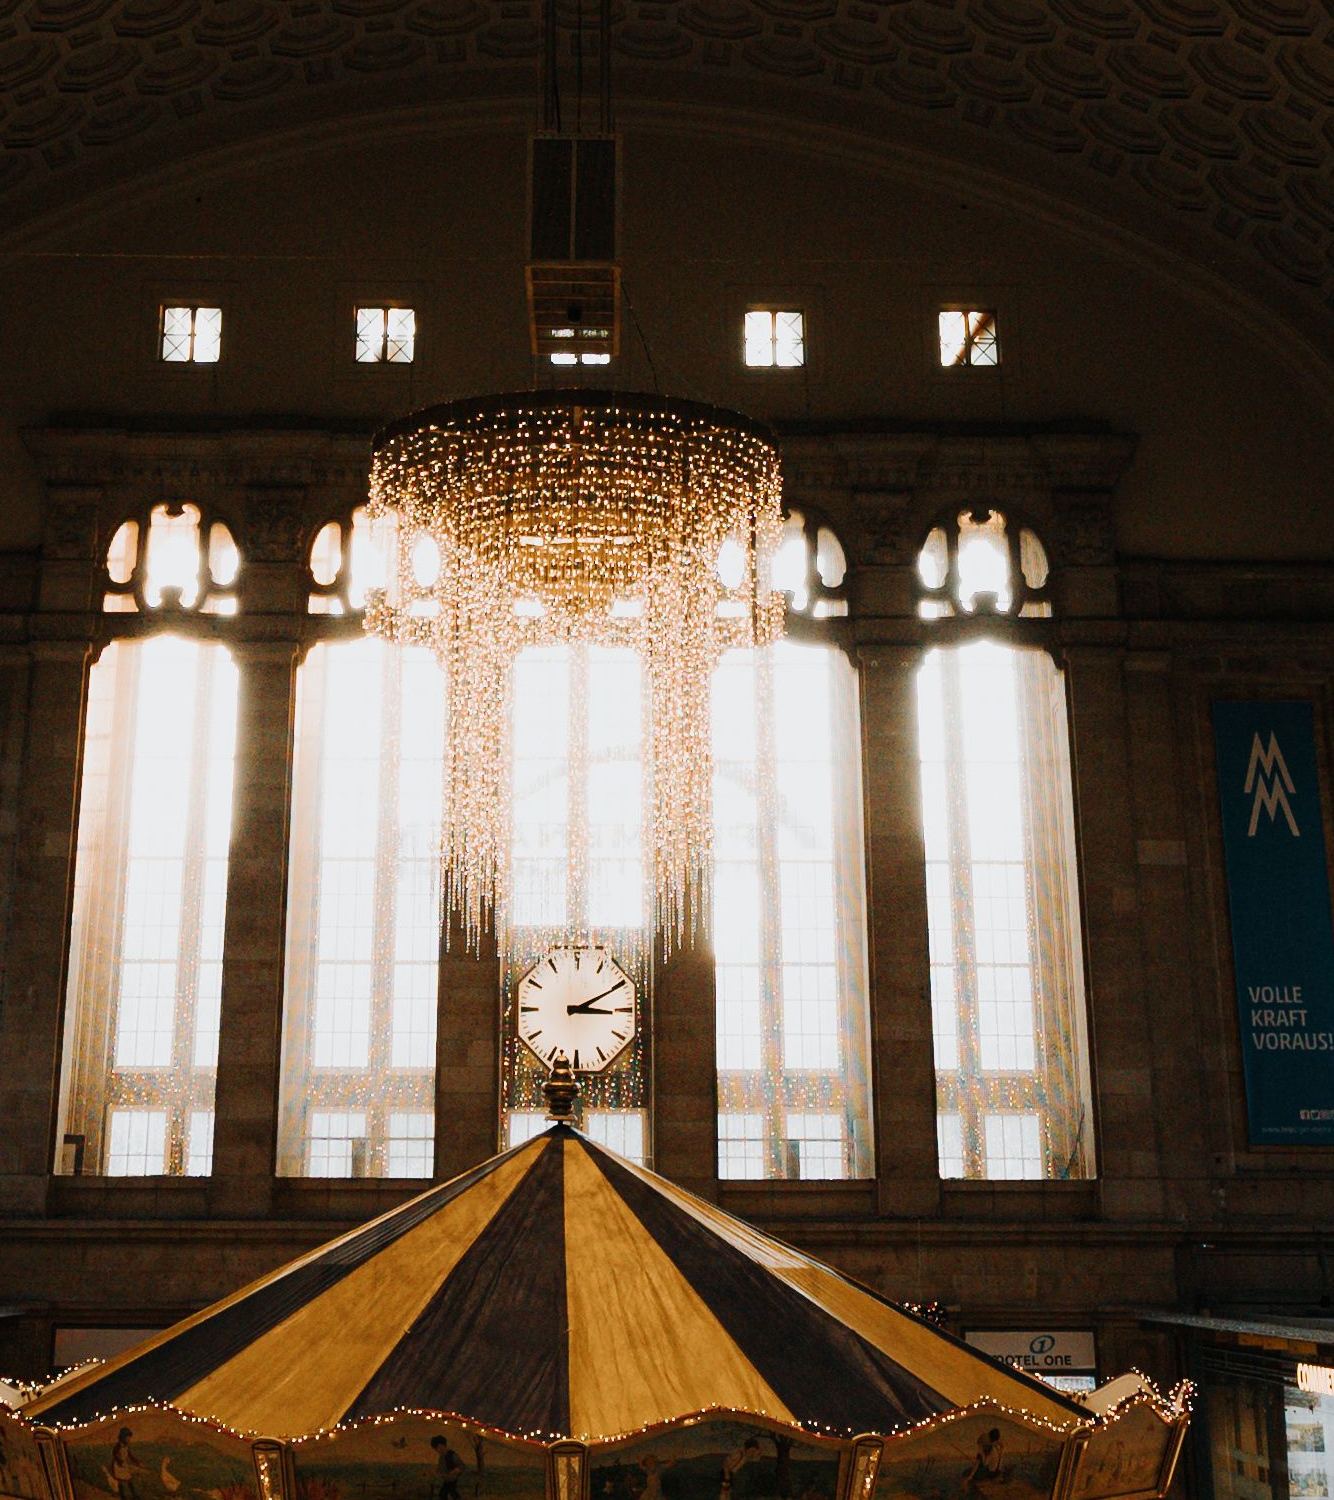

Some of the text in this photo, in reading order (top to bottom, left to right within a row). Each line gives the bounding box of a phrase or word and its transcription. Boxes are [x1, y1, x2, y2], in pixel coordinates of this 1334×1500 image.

[1248, 986, 1303, 1003] VOLLE
[1251, 1009, 1307, 1027] KRAFT
[1252, 1032, 1334, 1050] VORAUS!
